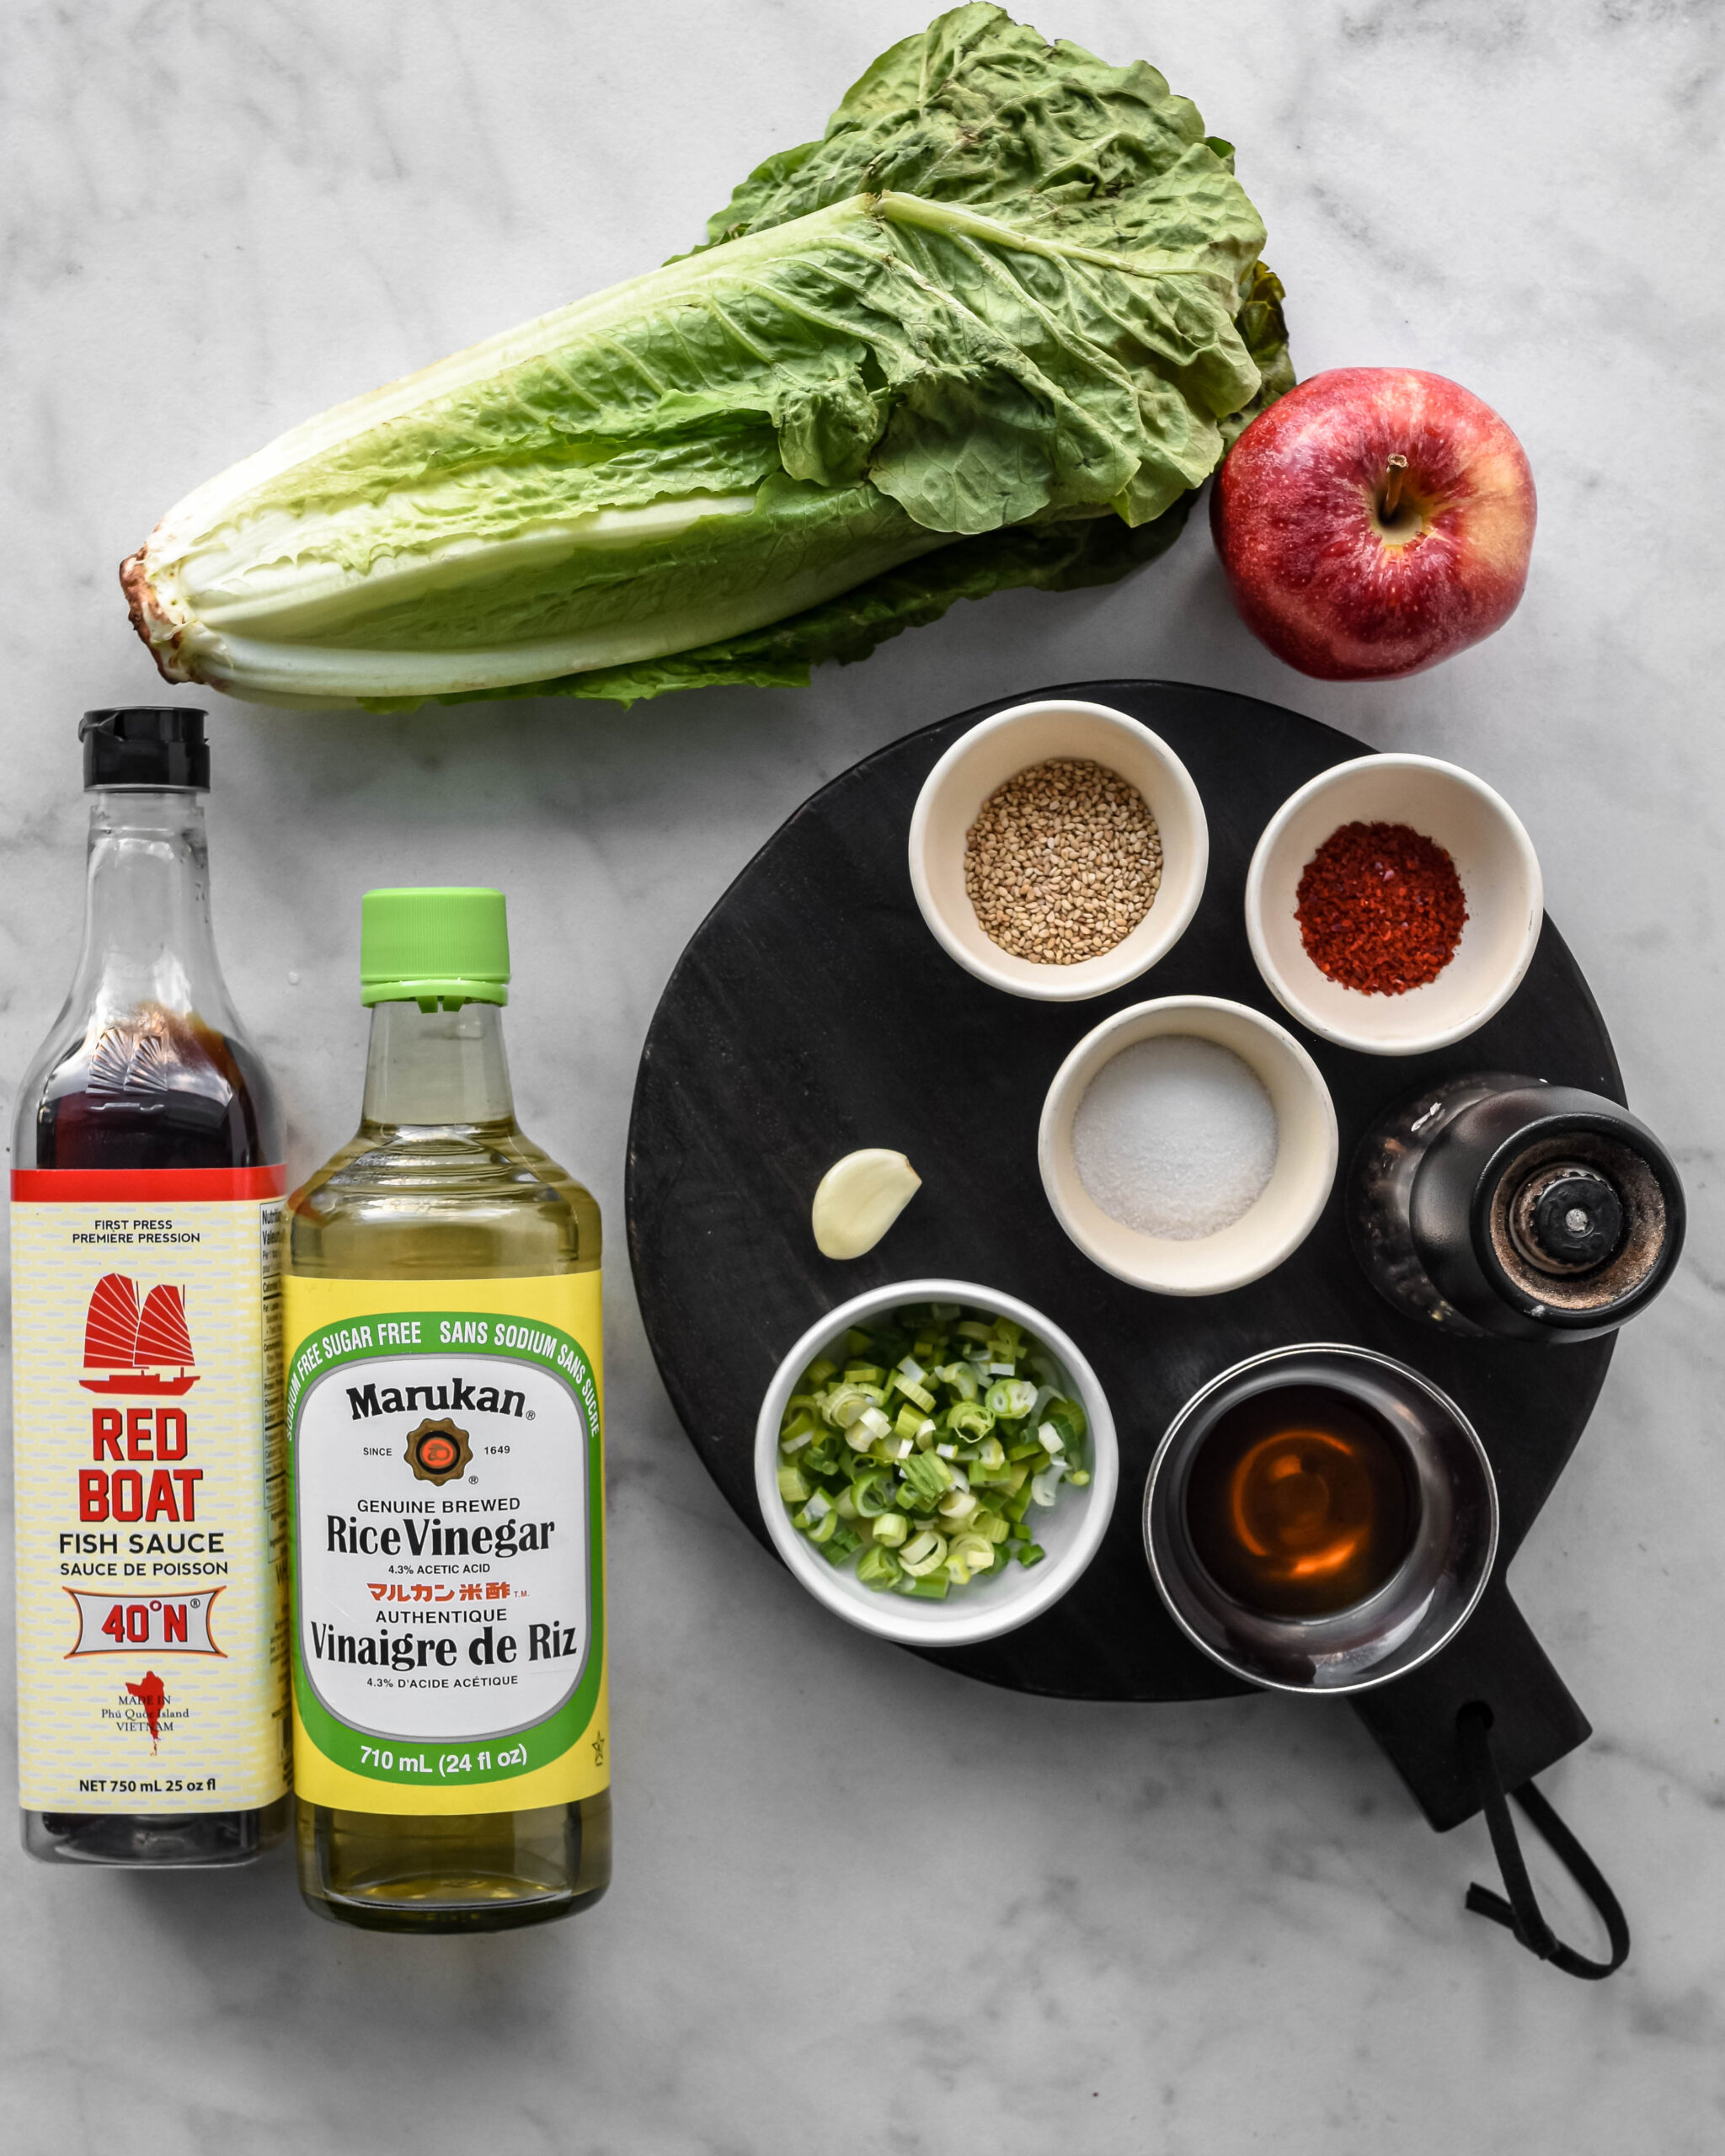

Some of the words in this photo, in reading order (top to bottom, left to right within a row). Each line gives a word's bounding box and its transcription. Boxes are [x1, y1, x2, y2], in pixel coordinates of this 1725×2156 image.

[94, 1220, 129, 1230] FIRST
[133, 1220, 173, 1230] PRESS
[72, 1230, 134, 1243] PREMIÈRE
[138, 1233, 200, 1243] PRESSION
[286, 1372, 302, 1442] SODIUM
[296, 1342, 323, 1382] FREE
[322, 1325, 373, 1359] SUGAR
[377, 1321, 421, 1344] FREE
[440, 1321, 488, 1345] SANS
[494, 1323, 558, 1359] SODIUM
[557, 1343, 586, 1385] SANS
[581, 1378, 600, 1438] SUCRE
[92, 1408, 188, 1461] RED
[363, 1446, 393, 1457] SINCE
[483, 1445, 511, 1455] 1649
[78, 1469, 203, 1523] BOAT
[357, 1499, 436, 1513] GENUINE
[442, 1497, 521, 1513] BREWED
[60, 1534, 118, 1554] FISH
[129, 1533, 224, 1553] SAUCE
[326, 1514, 402, 1556] Rice
[403, 1518, 556, 1558] Vinegar
[60, 1563, 117, 1576] SAUCE
[124, 1564, 146, 1576] DE
[152, 1562, 228, 1576] POISSON
[387, 1565, 414, 1575] 4.3%
[416, 1565, 460, 1575] ACETIC
[462, 1563, 491, 1574] ACID
[376, 1608, 508, 1625] AUTHENTIQUE
[310, 1620, 458, 1673] Vinaigre
[467, 1625, 518, 1666] de
[527, 1620, 578, 1662] Riz
[366, 1677, 394, 1689] 4.3%
[398, 1678, 450, 1689] D'ACIDE
[453, 1674, 519, 1689] ACÉTIQUE
[119, 1695, 155, 1705] MADE
[158, 1695, 171, 1705] IN
[158, 1708, 190, 1719] Island
[116, 1721, 174, 1732] VIETNAM
[360, 1745, 394, 1770] 710
[398, 1753, 434, 1774] mL
[438, 1753, 473, 1778] (24
[477, 1752, 493, 1770] fl
[496, 1743, 528, 1767] oz)
[79, 1780, 107, 1792] NET
[110, 1780, 136, 1792] 750
[140, 1780, 162, 1792] mL
[166, 1780, 183, 1791] 25
[187, 1781, 205, 1791] oz
[207, 1779, 216, 1790] fl
